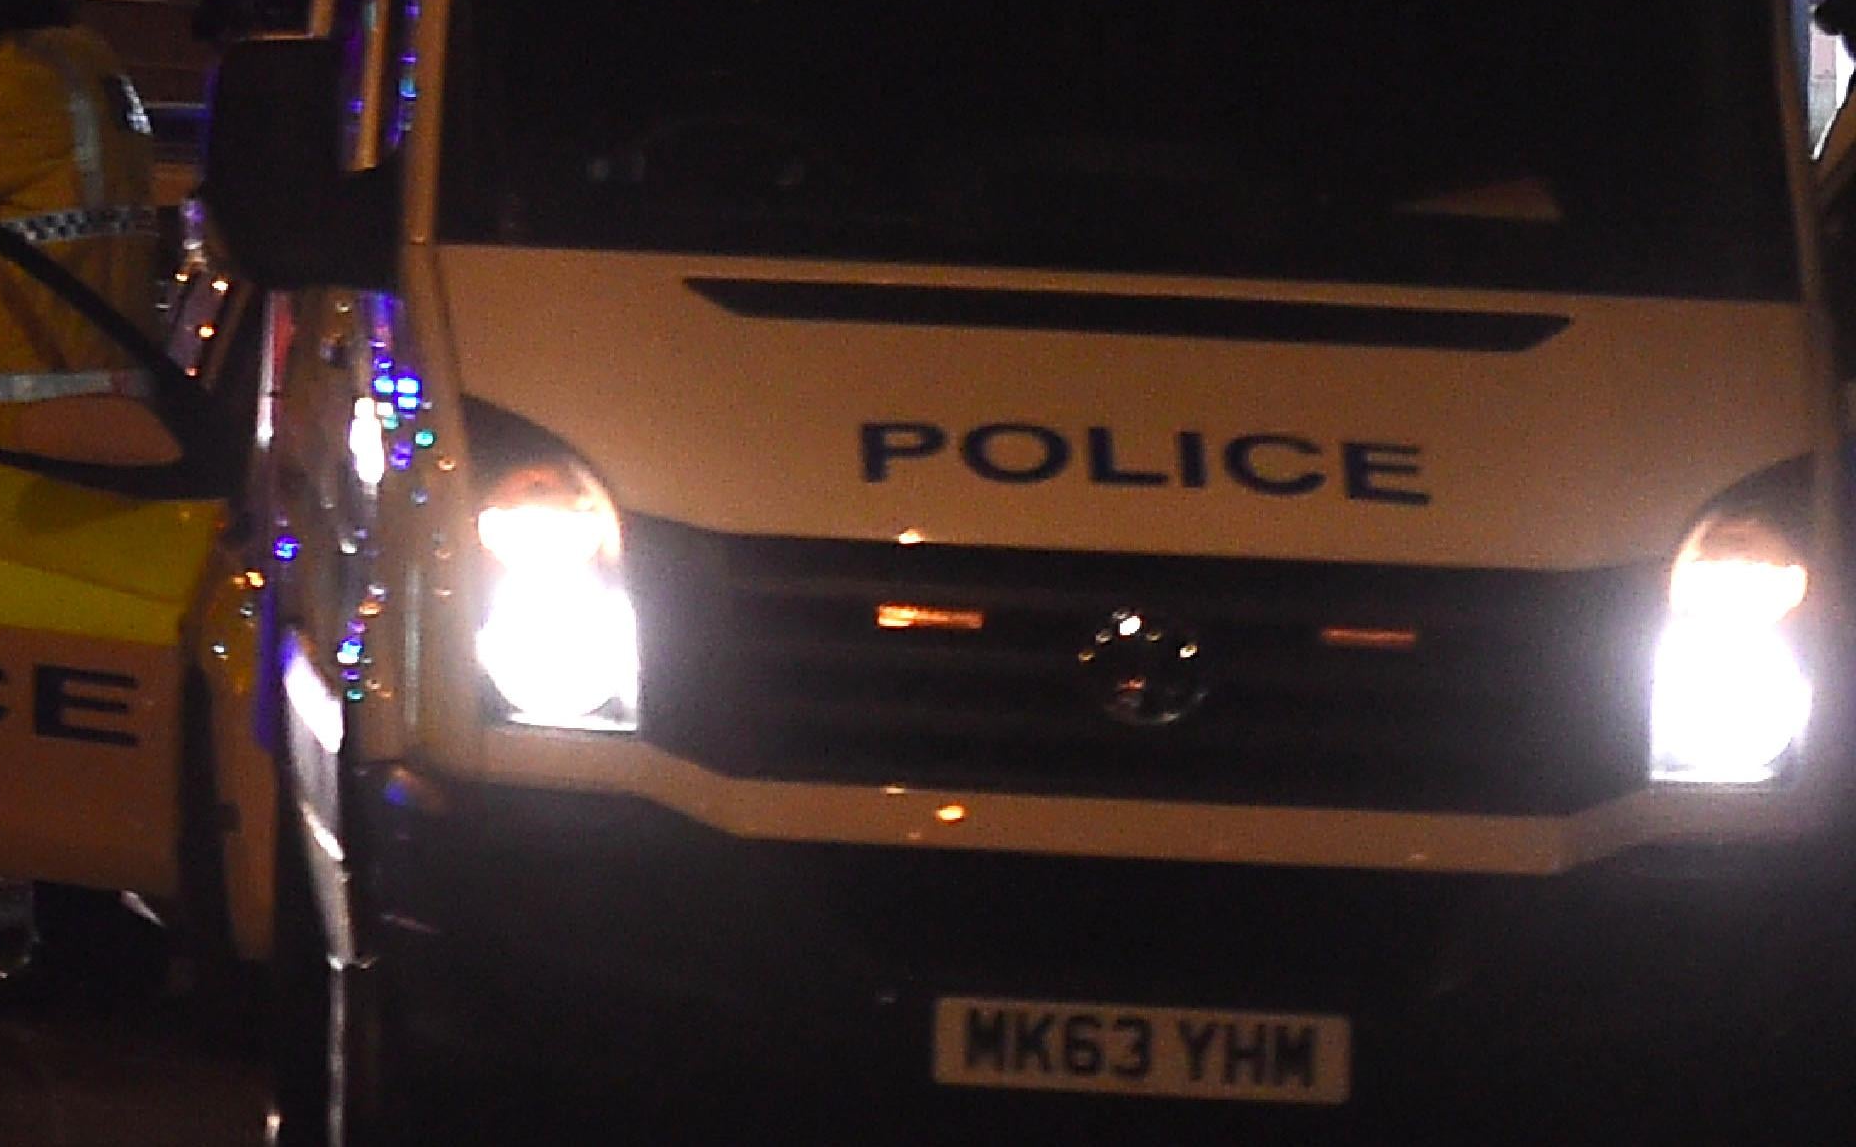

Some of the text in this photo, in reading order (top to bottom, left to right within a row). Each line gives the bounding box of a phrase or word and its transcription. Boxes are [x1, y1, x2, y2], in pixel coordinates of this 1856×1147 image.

[861, 423, 1430, 504] POLICE
[967, 1008, 1315, 1087] MK63 YHM
